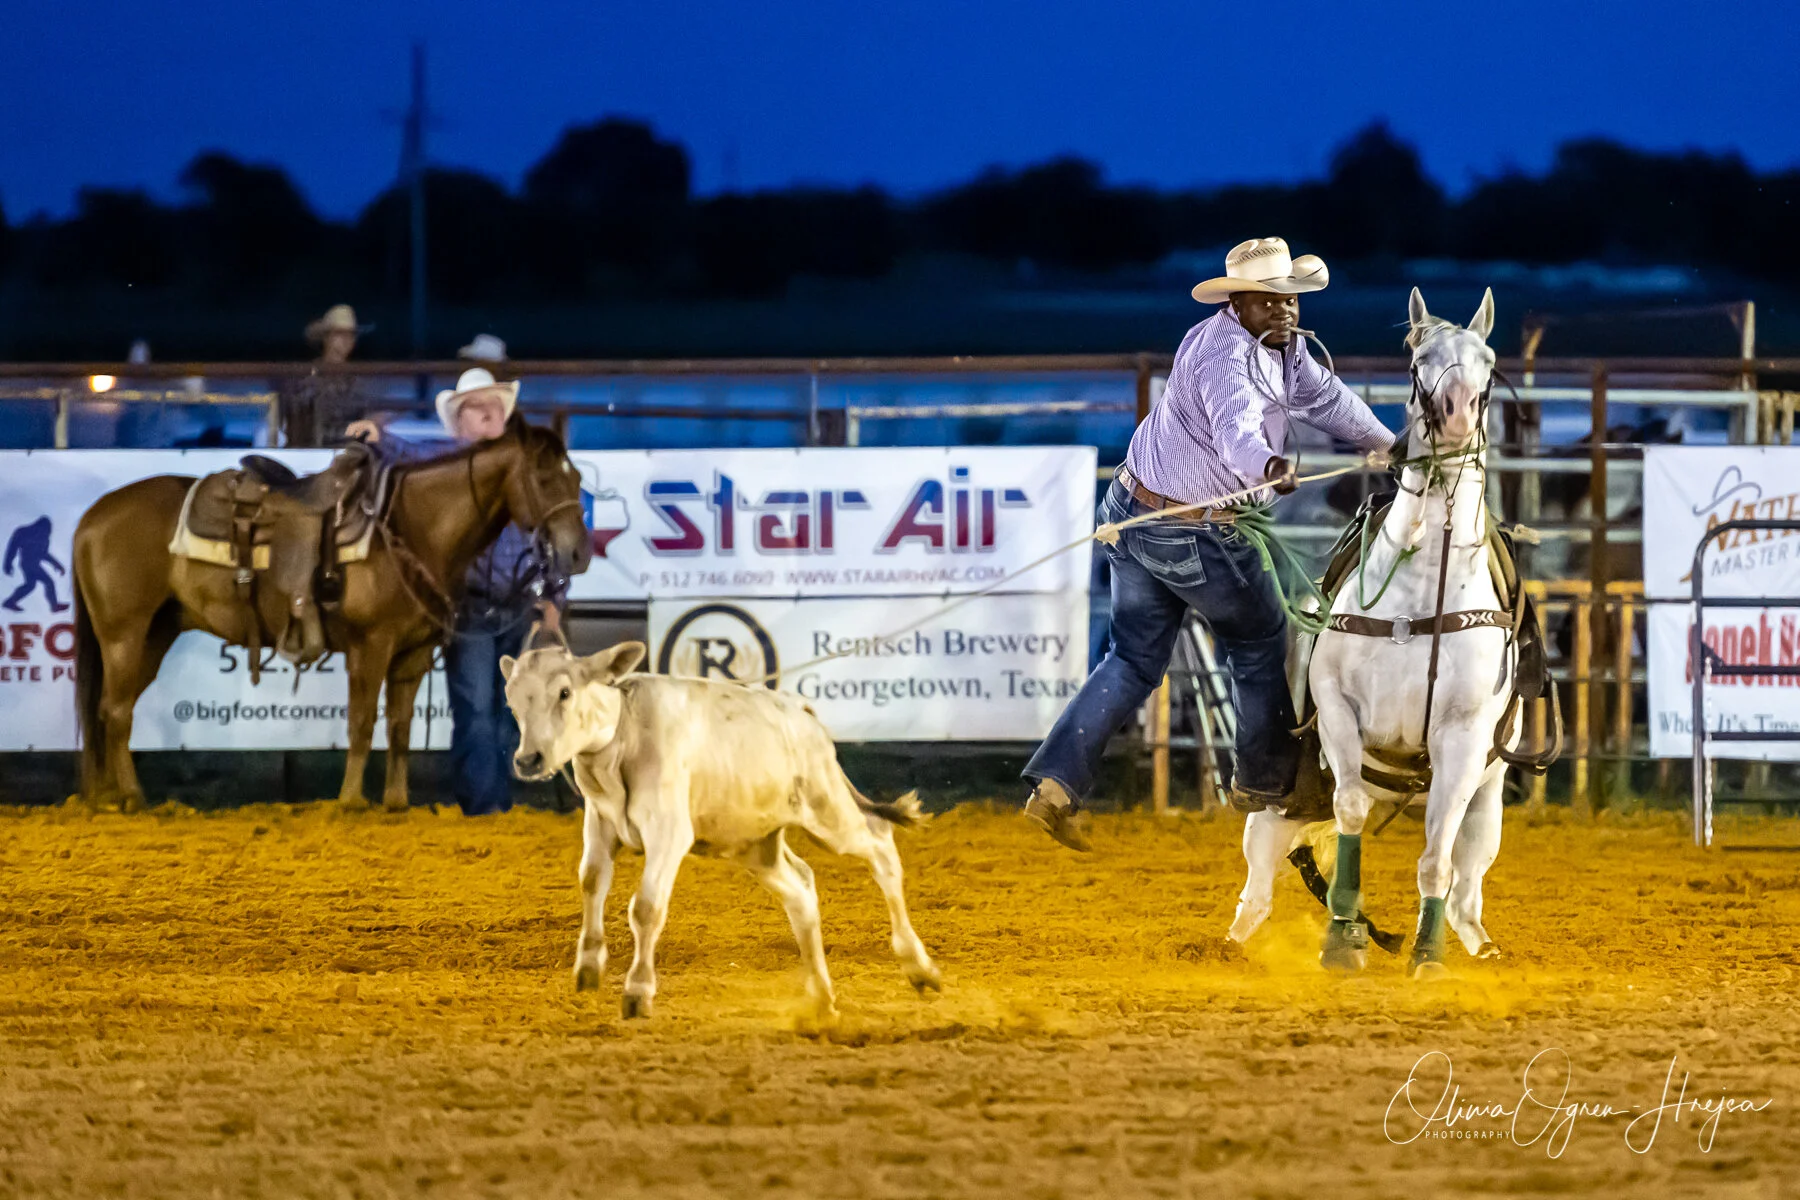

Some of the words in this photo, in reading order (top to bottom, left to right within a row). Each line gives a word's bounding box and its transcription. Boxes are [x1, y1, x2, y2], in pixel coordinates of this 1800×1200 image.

[643, 467, 872, 556] Star
[873, 465, 1033, 555] Air
[1711, 542, 1789, 576] MASTER
[692, 638, 739, 680] R
[812, 630, 931, 657] Rentsch
[944, 629, 1070, 661] Brewery
[796, 673, 991, 706] Georgetown,
[1000, 670, 1080, 698] Texas
